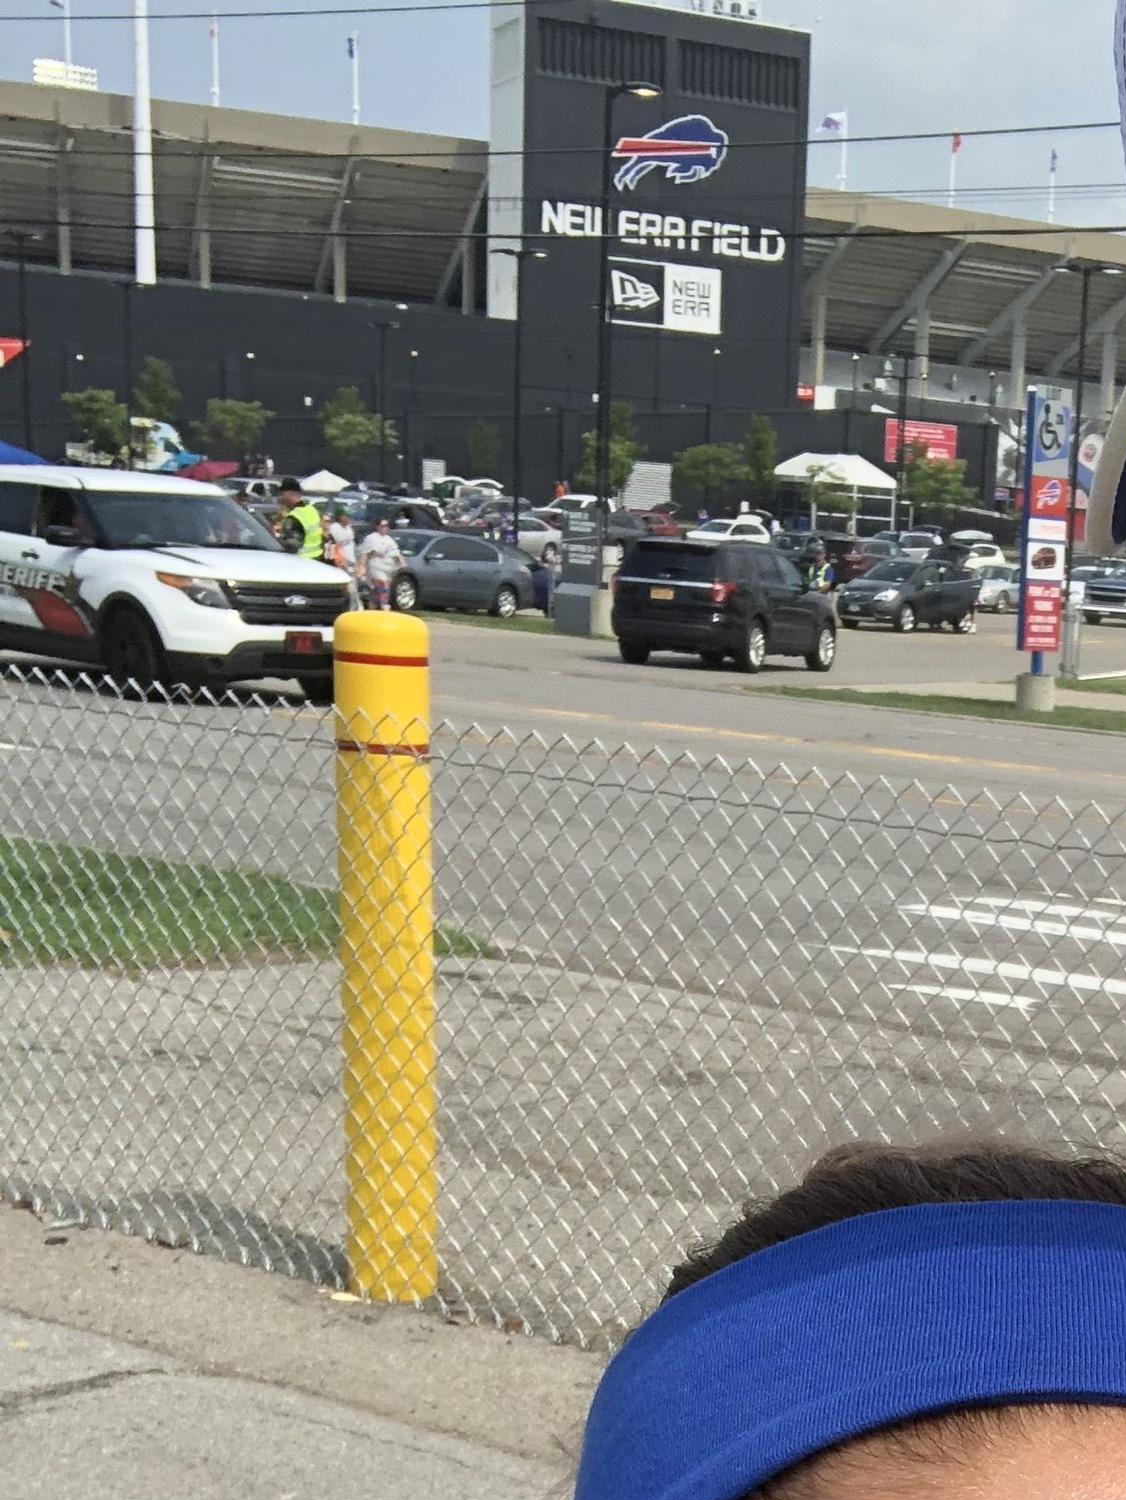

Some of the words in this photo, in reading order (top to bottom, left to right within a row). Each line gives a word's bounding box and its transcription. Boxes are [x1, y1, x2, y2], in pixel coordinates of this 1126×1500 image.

[618, 210, 686, 250] ERA
[690, 219, 786, 261] FIELD
[671, 279, 712, 299] NEW
[671, 299, 712, 318] ERA
